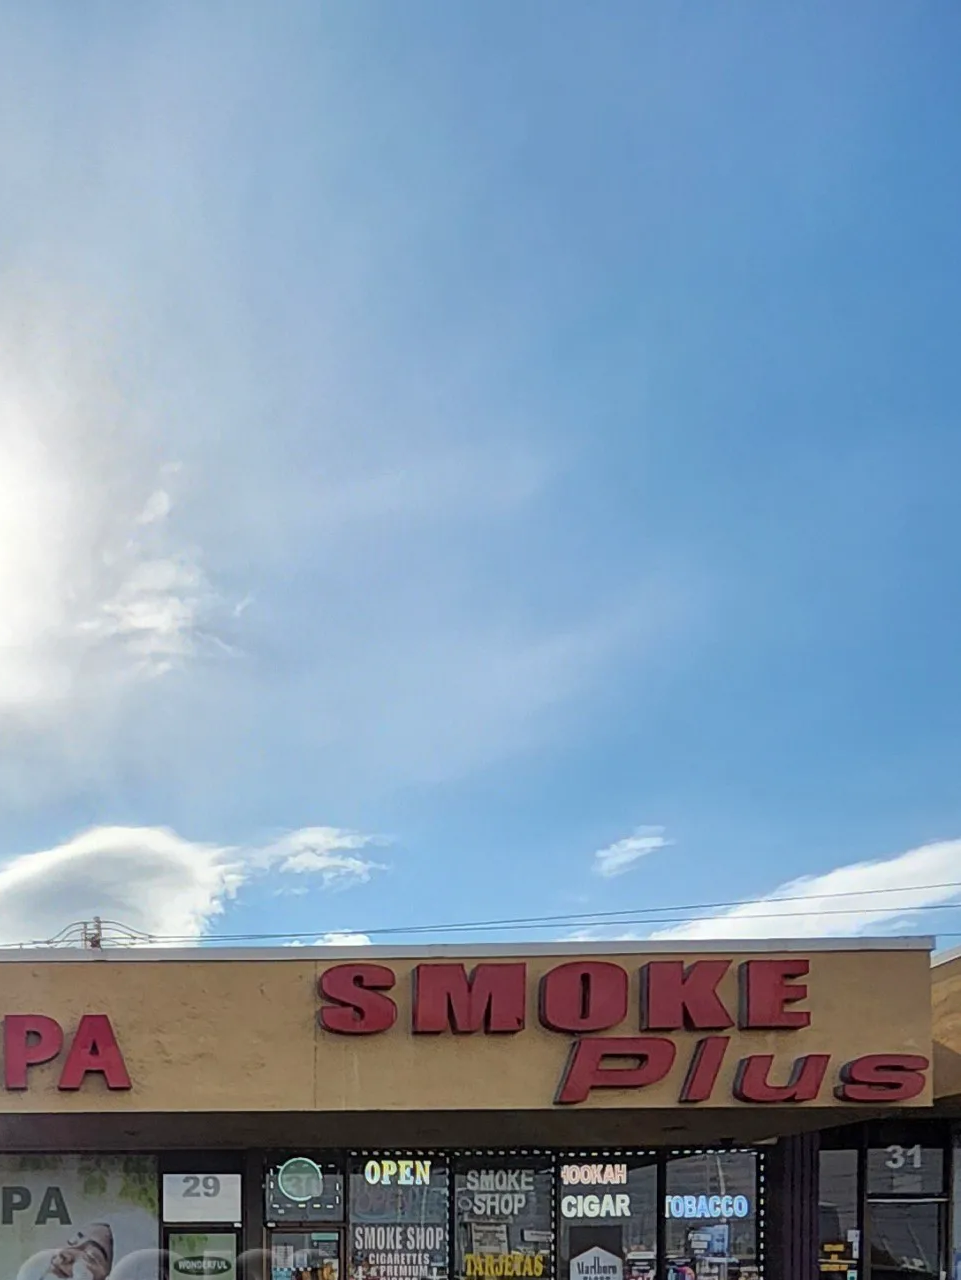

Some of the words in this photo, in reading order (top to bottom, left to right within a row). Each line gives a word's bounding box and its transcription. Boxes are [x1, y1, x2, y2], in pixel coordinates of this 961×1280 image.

[319, 958, 812, 1037] SMOKE
[553, 1035, 932, 1106] Plus
[885, 1144, 921, 1168] 31
[364, 1159, 432, 1186] OPEN
[466, 1168, 535, 1191] SMOKE
[181, 1175, 221, 1198] 29
[472, 1193, 527, 1216] SHOP
[561, 1193, 631, 1218] CIGAR
[354, 1226, 403, 1251] SMOKE
[406, 1226, 444, 1251] SHOP
[177, 1259, 228, 1271] WONDERFUL
[368, 1253, 430, 1265] CIGARETTES
[464, 1253, 544, 1277] TARJETAS
[576, 1256, 618, 1275] Marlboro
[379, 1265, 429, 1277] PREMIUM
